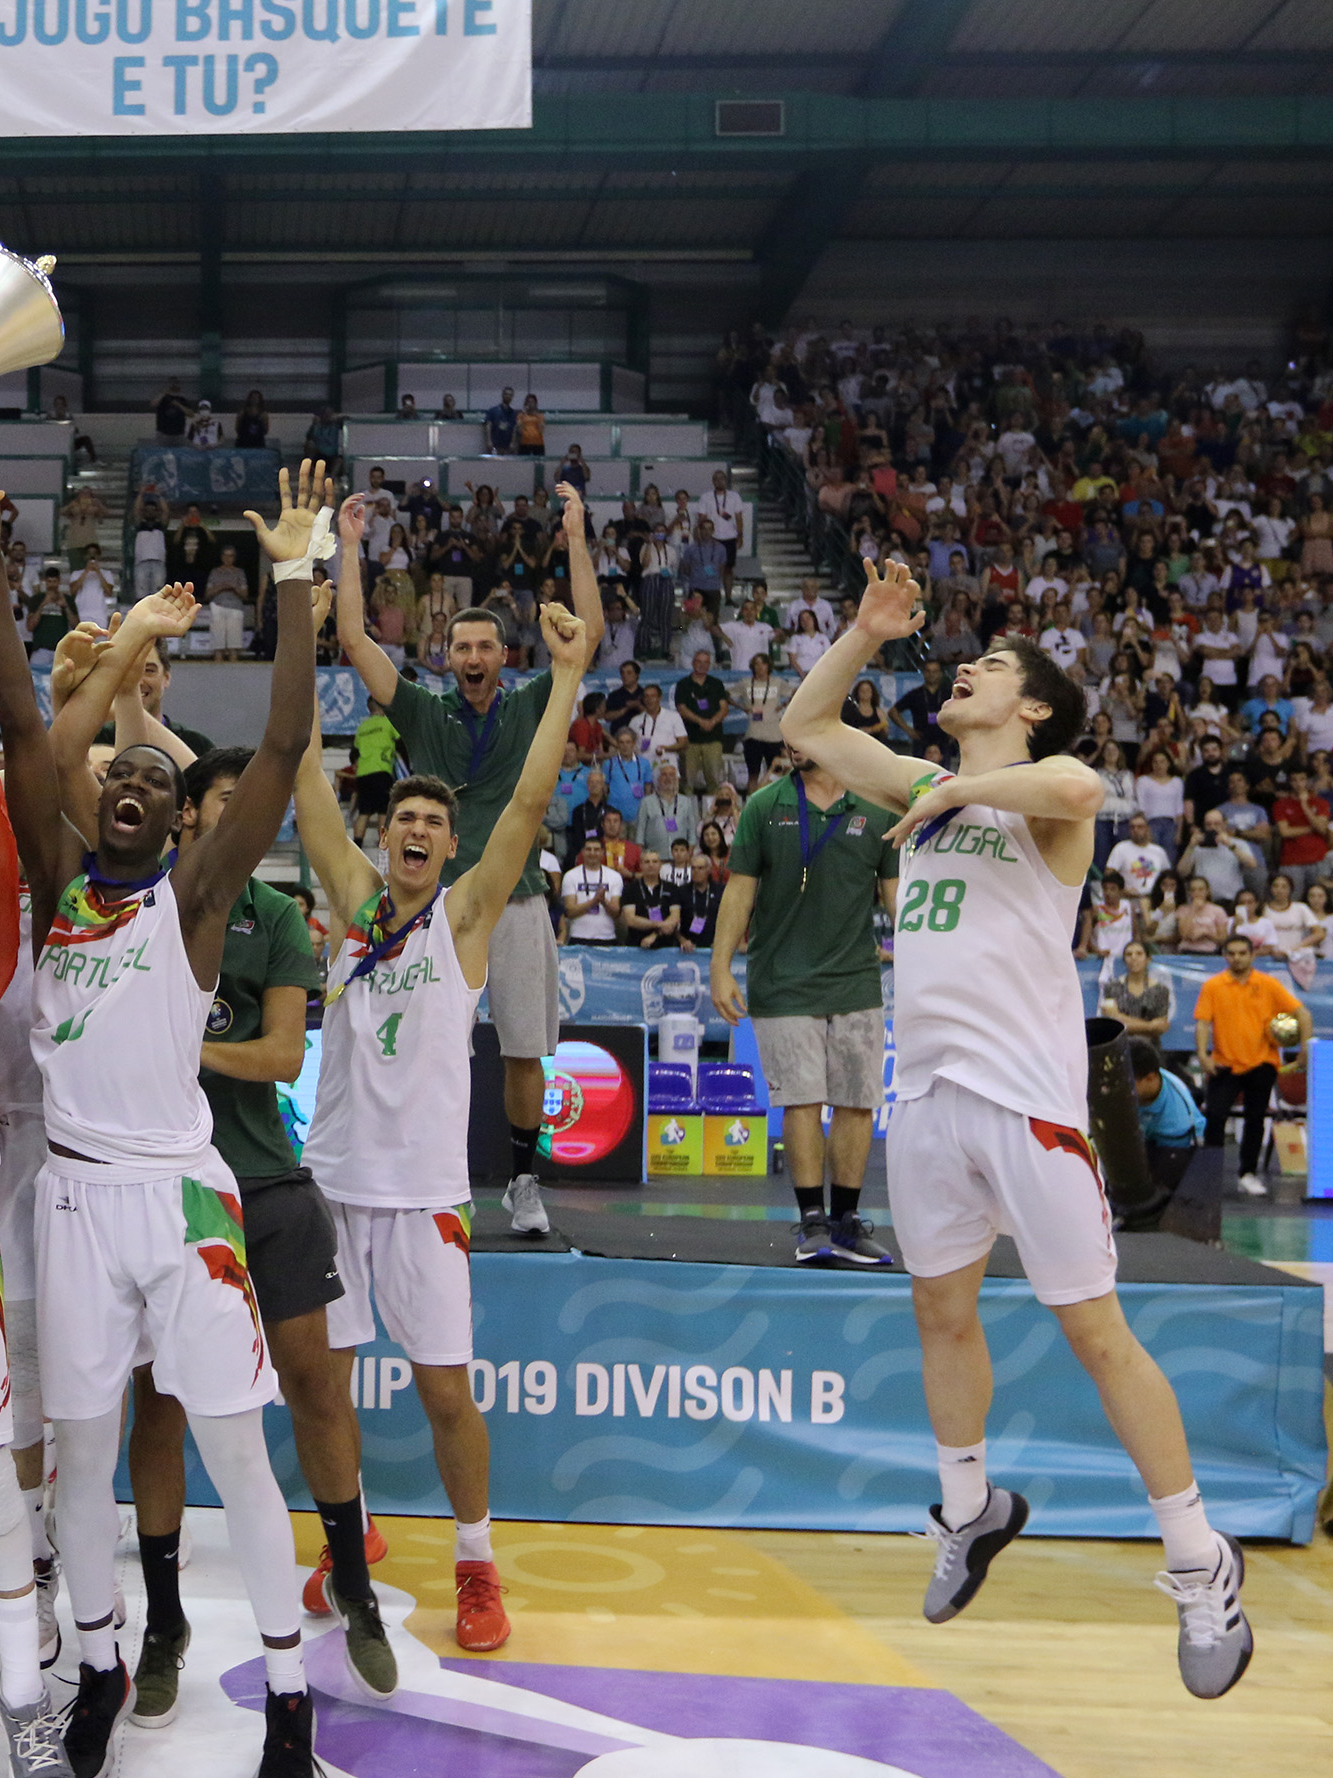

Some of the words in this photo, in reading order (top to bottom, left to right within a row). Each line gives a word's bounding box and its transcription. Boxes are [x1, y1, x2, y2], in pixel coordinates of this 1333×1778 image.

[174, 0, 498, 44] BASQUETE
[113, 56, 146, 116] E
[162, 52, 279, 116] TU?
[898, 878, 967, 933] 28
[376, 1012, 403, 1056] 4
[575, 1362, 793, 1423] DIVISON
[811, 1370, 846, 1424] B
